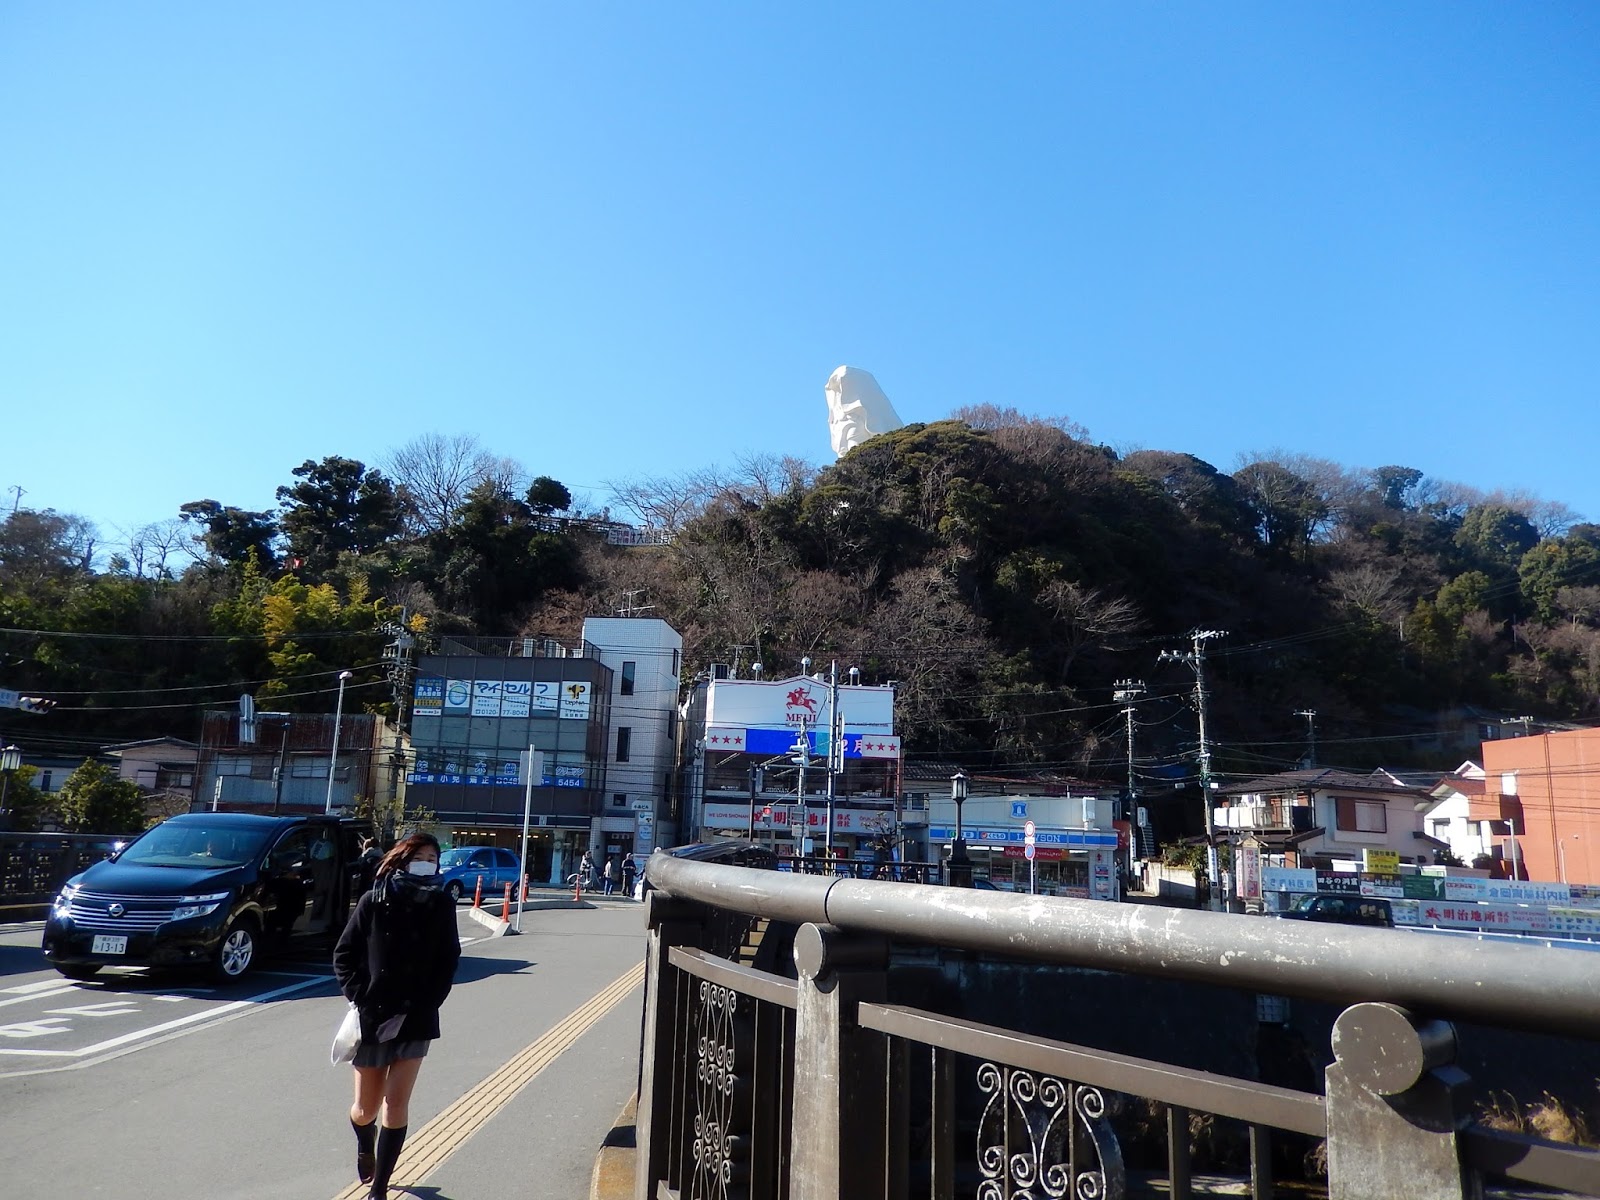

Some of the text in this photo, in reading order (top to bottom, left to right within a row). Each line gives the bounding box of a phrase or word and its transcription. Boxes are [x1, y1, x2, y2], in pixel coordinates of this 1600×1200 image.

[476, 682, 548, 695] マイセルフ
[1016, 833, 1061, 843] LSON
[101, 943, 124, 953] 13-13
